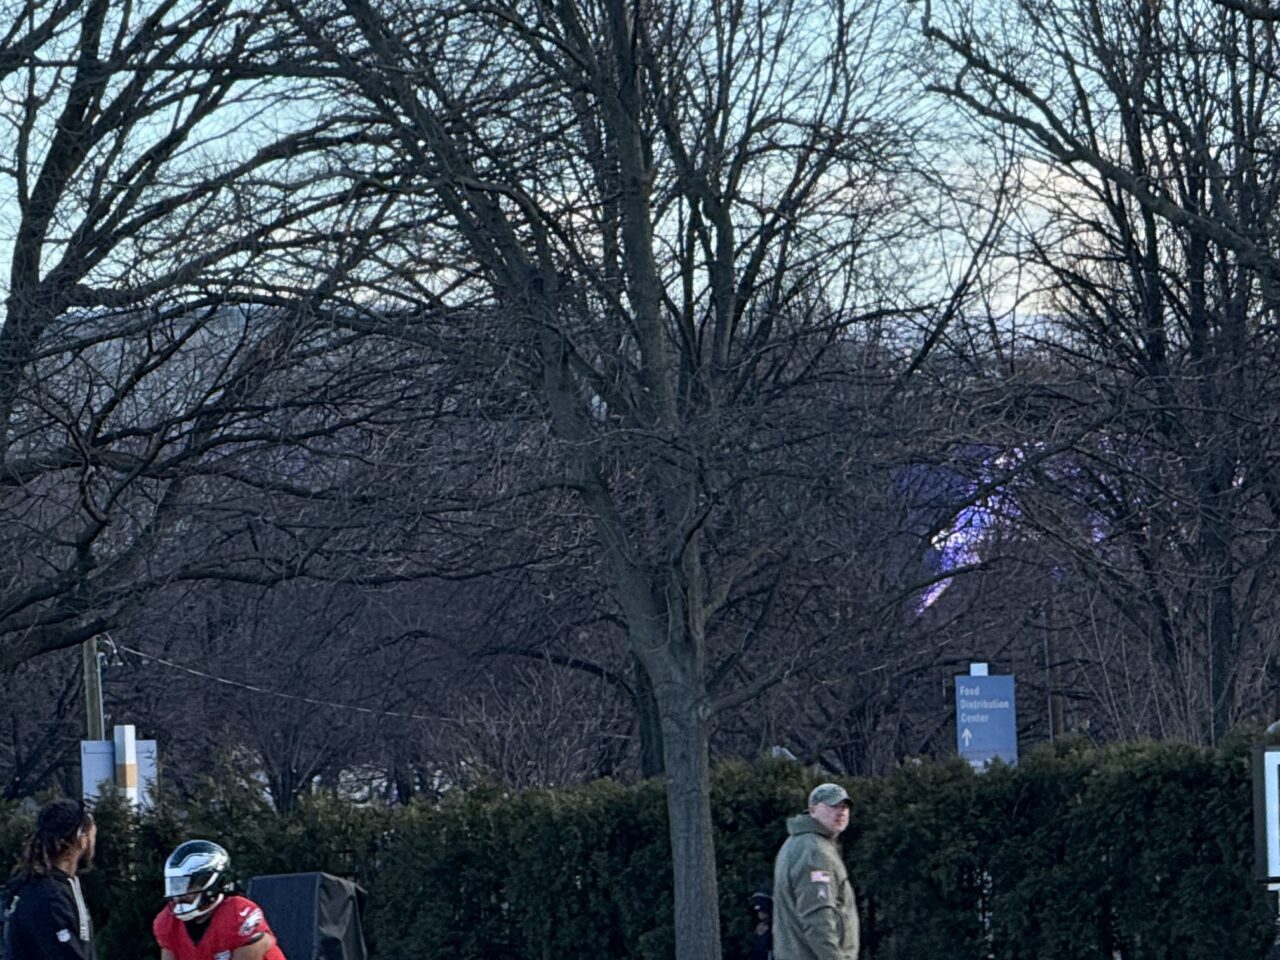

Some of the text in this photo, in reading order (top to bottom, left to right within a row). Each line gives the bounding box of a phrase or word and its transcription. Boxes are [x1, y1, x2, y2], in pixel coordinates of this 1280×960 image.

[960, 686, 980, 696] Food
[960, 700, 1009, 709] Distribution
[961, 713, 989, 722] Center
